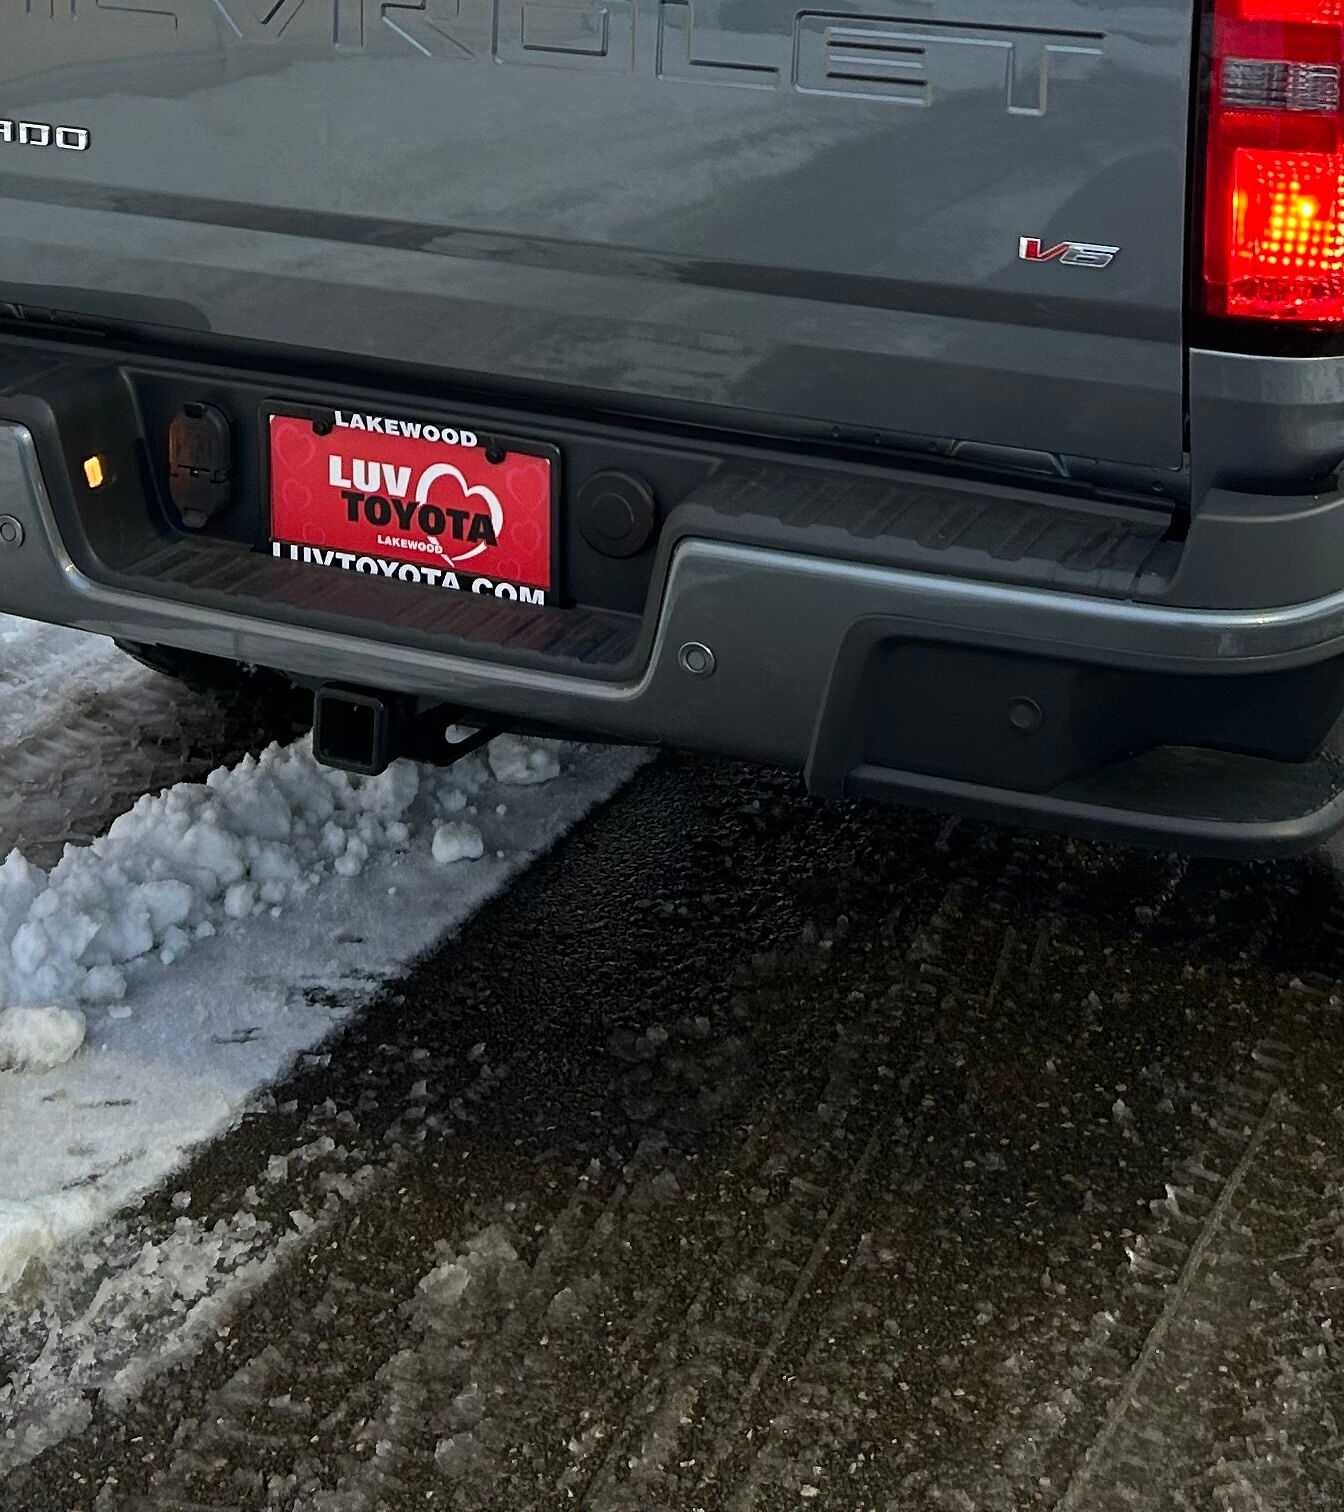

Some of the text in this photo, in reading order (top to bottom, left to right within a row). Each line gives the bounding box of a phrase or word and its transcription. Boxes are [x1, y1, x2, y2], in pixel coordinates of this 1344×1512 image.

[1018, 236, 1121, 268] V6
[334, 410, 478, 448] LAKEWOOD
[328, 454, 412, 498] LUV
[340, 490, 498, 546] TOYOTA
[377, 534, 444, 555] LAKEWOOD
